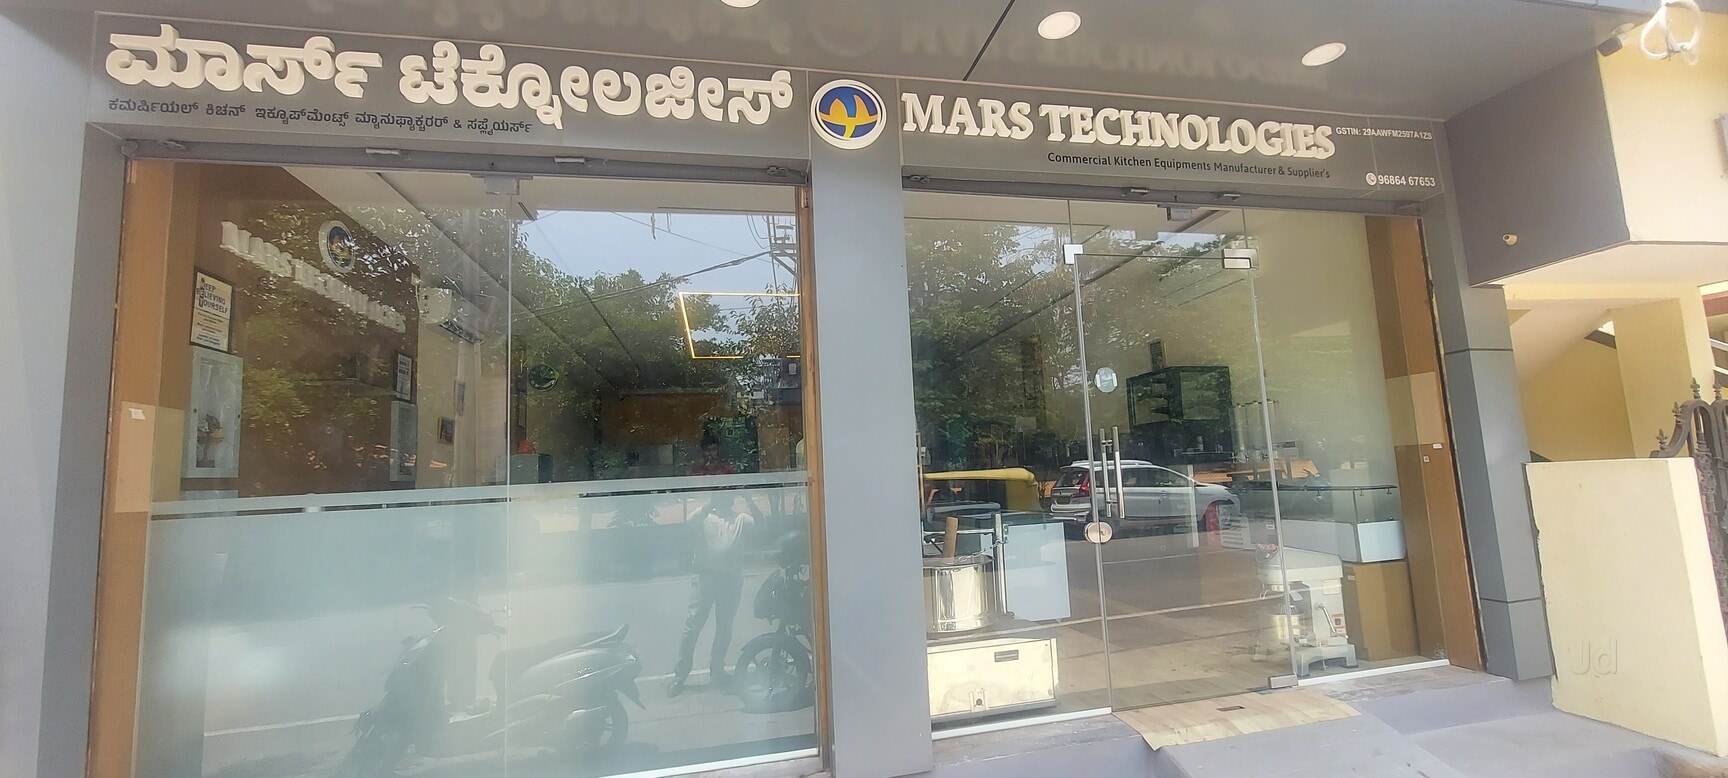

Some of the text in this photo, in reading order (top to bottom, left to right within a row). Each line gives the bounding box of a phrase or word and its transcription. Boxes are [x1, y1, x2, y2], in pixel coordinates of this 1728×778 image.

[106, 24, 794, 129] ಮಾರ್ಸ್ ಟೆಕ್ನೋಲಜೀಸ್
[108, 98, 199, 115] ಕಮರ್ಷಿಯಲ್
[206, 102, 246, 117] ಕಿಚನ್
[453, 119, 462, 129] &
[902, 93, 1336, 159] MARS TECHNOLOGIES
[1336, 127, 1362, 136] GSTIN:
[1047, 151, 1331, 179] Commercial Kitchen Equipments Manufacturer & Supplier's
[1378, 174, 1437, 187] 96864 67653
